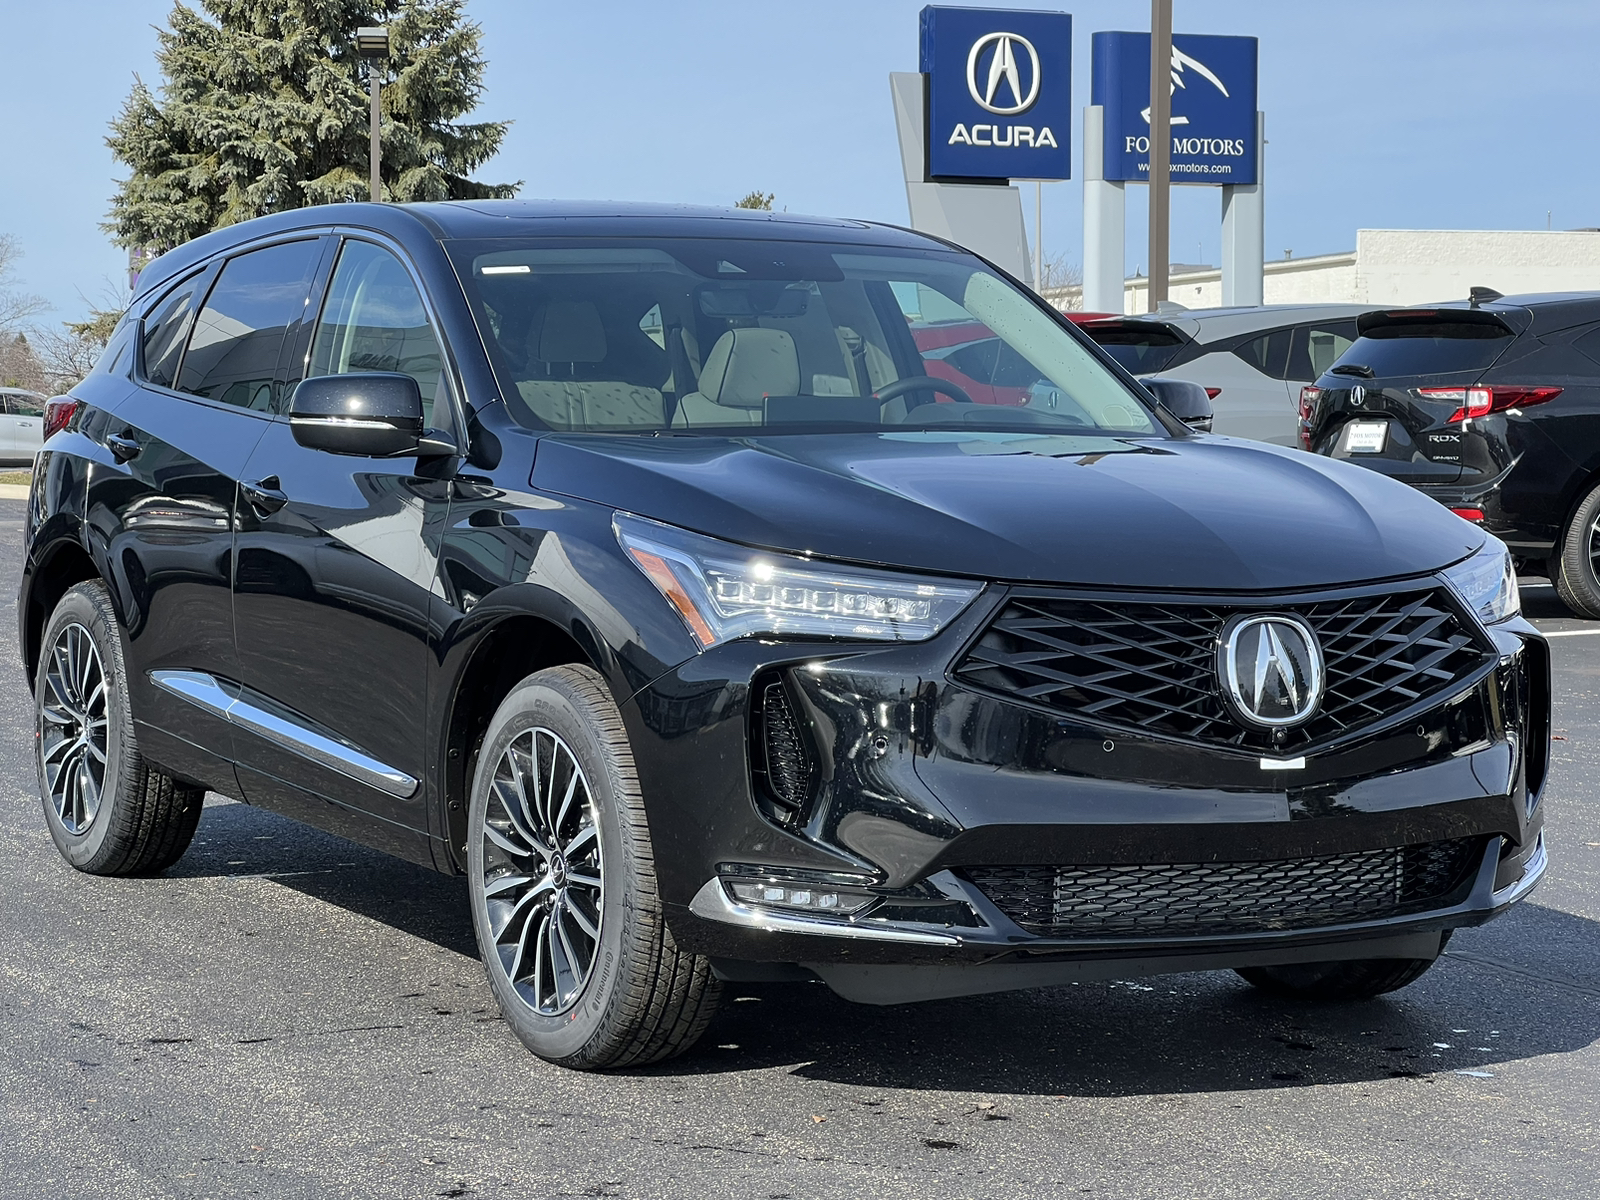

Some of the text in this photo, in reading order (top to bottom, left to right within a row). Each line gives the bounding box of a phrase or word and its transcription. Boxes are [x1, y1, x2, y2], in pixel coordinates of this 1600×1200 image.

[948, 123, 1058, 148] ACURA
[1125, 136, 1244, 156] FO MOTORS
